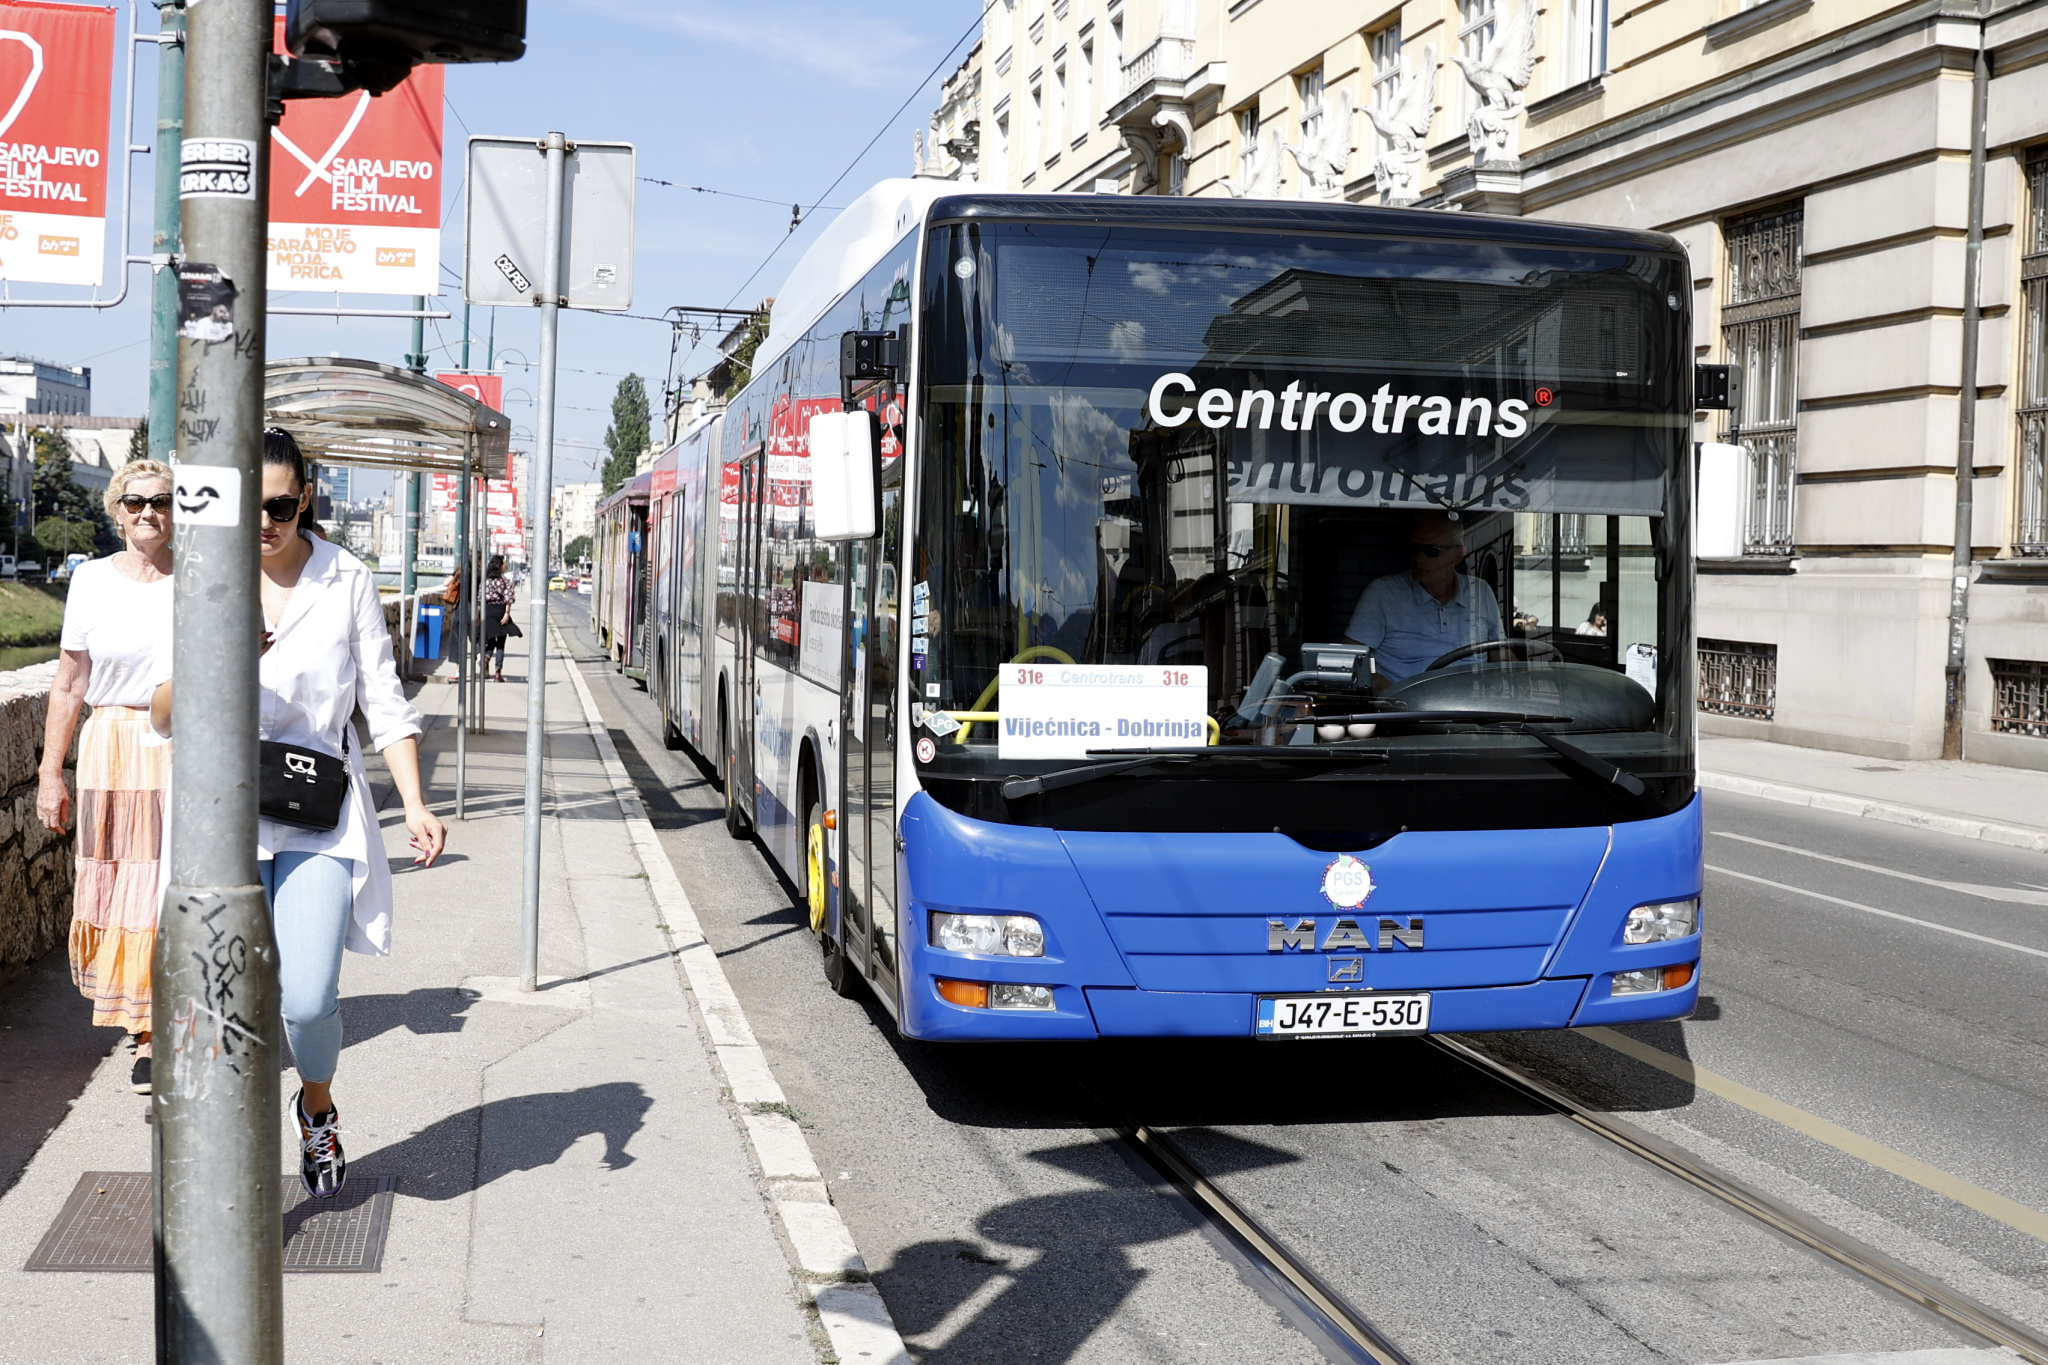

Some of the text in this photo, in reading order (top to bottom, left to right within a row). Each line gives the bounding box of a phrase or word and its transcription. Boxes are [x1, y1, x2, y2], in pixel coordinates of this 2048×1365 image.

[0, 142, 100, 168] SARAJEVO
[332, 157, 433, 180] SARAJEVO
[332, 175, 379, 195] FILM
[331, 193, 423, 214] FESTIVAL
[305, 227, 351, 241] MOJE
[266, 237, 357, 254] SARAJEVO
[276, 252, 323, 266] MOJA
[290, 261, 343, 280] PRIČA
[1149, 371, 1530, 439] Centrotrans
[1018, 668, 1188, 686] 31e Centrotrans 31e
[930, 717, 953, 730] LPG
[1005, 717, 1100, 738] Vijećnica
[1117, 718, 1202, 739] Dobrinja
[1333, 871, 1363, 886] PGS
[1267, 914, 1424, 951] MAN
[1259, 1020, 1274, 1028] BIH
[1279, 1000, 1422, 1029] J47-E-530
